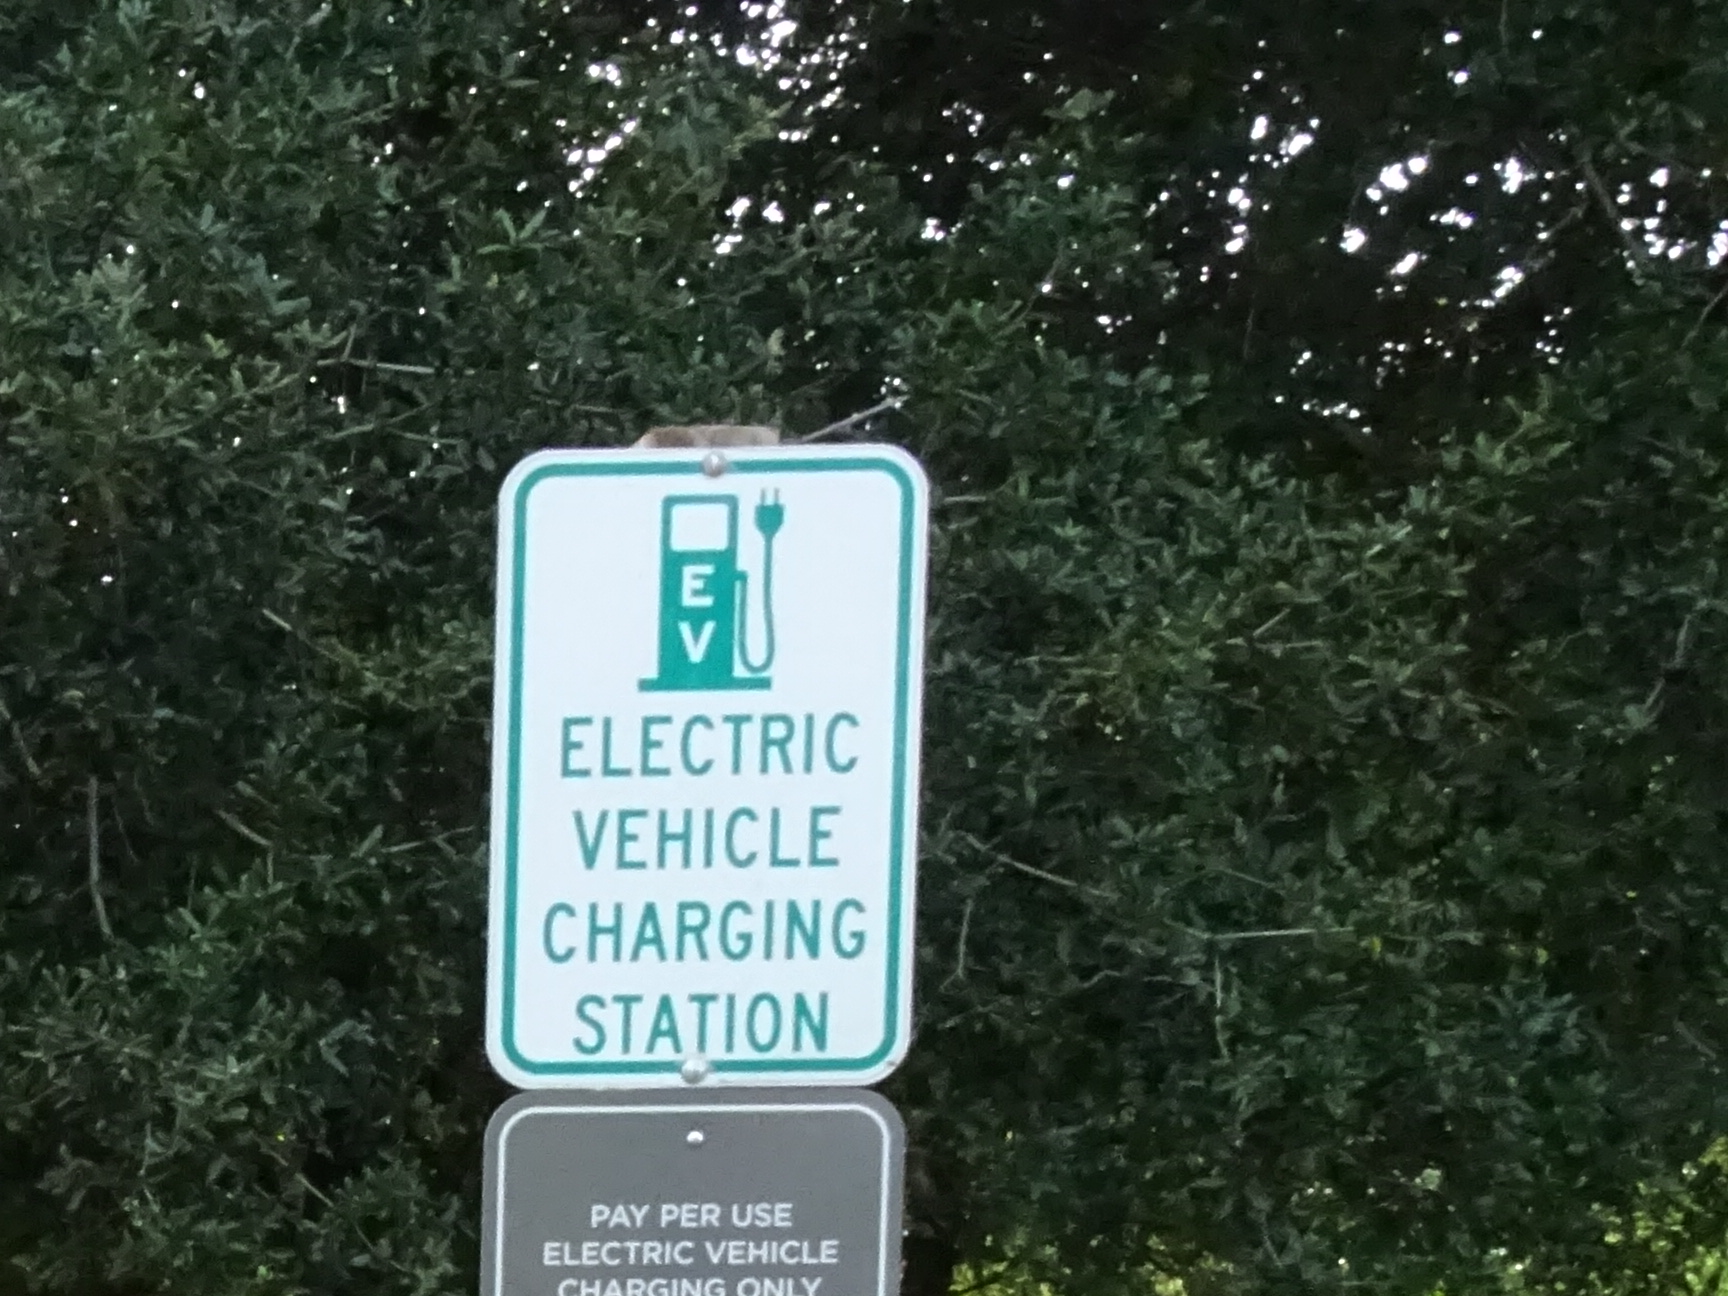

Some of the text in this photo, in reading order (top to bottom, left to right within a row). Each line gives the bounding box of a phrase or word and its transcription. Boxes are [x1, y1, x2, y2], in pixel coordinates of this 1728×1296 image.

[560, 712, 861, 778] ELECTRIC
[572, 805, 842, 870] VEHICLE
[542, 898, 868, 963] CHARGING
[572, 991, 830, 1055] STATION
[590, 1203, 794, 1228] PAY PER USE
[543, 1240, 839, 1266] ELECTRIC VEHICLE
